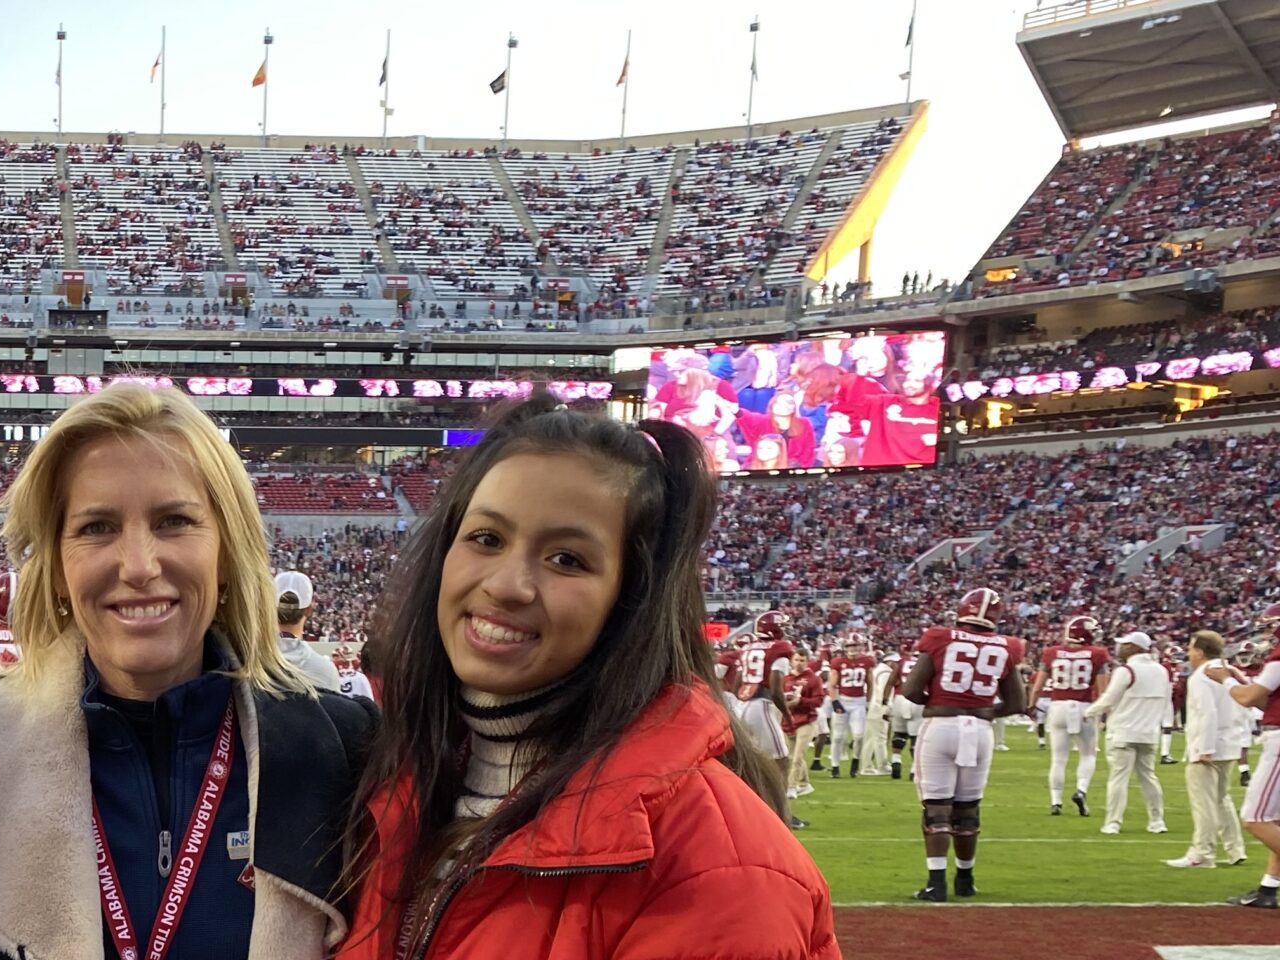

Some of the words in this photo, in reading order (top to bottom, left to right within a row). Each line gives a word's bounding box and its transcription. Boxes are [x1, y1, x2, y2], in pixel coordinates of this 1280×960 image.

[3, 425, 24, 441] TO
[840, 667, 867, 688] 20
[939, 641, 1009, 697] 69
[1051, 658, 1093, 690] 88
[185, 780, 219, 853] ALABAMA
[98, 866, 131, 940] ALABAMA
[163, 850, 195, 926] CRIMSON
